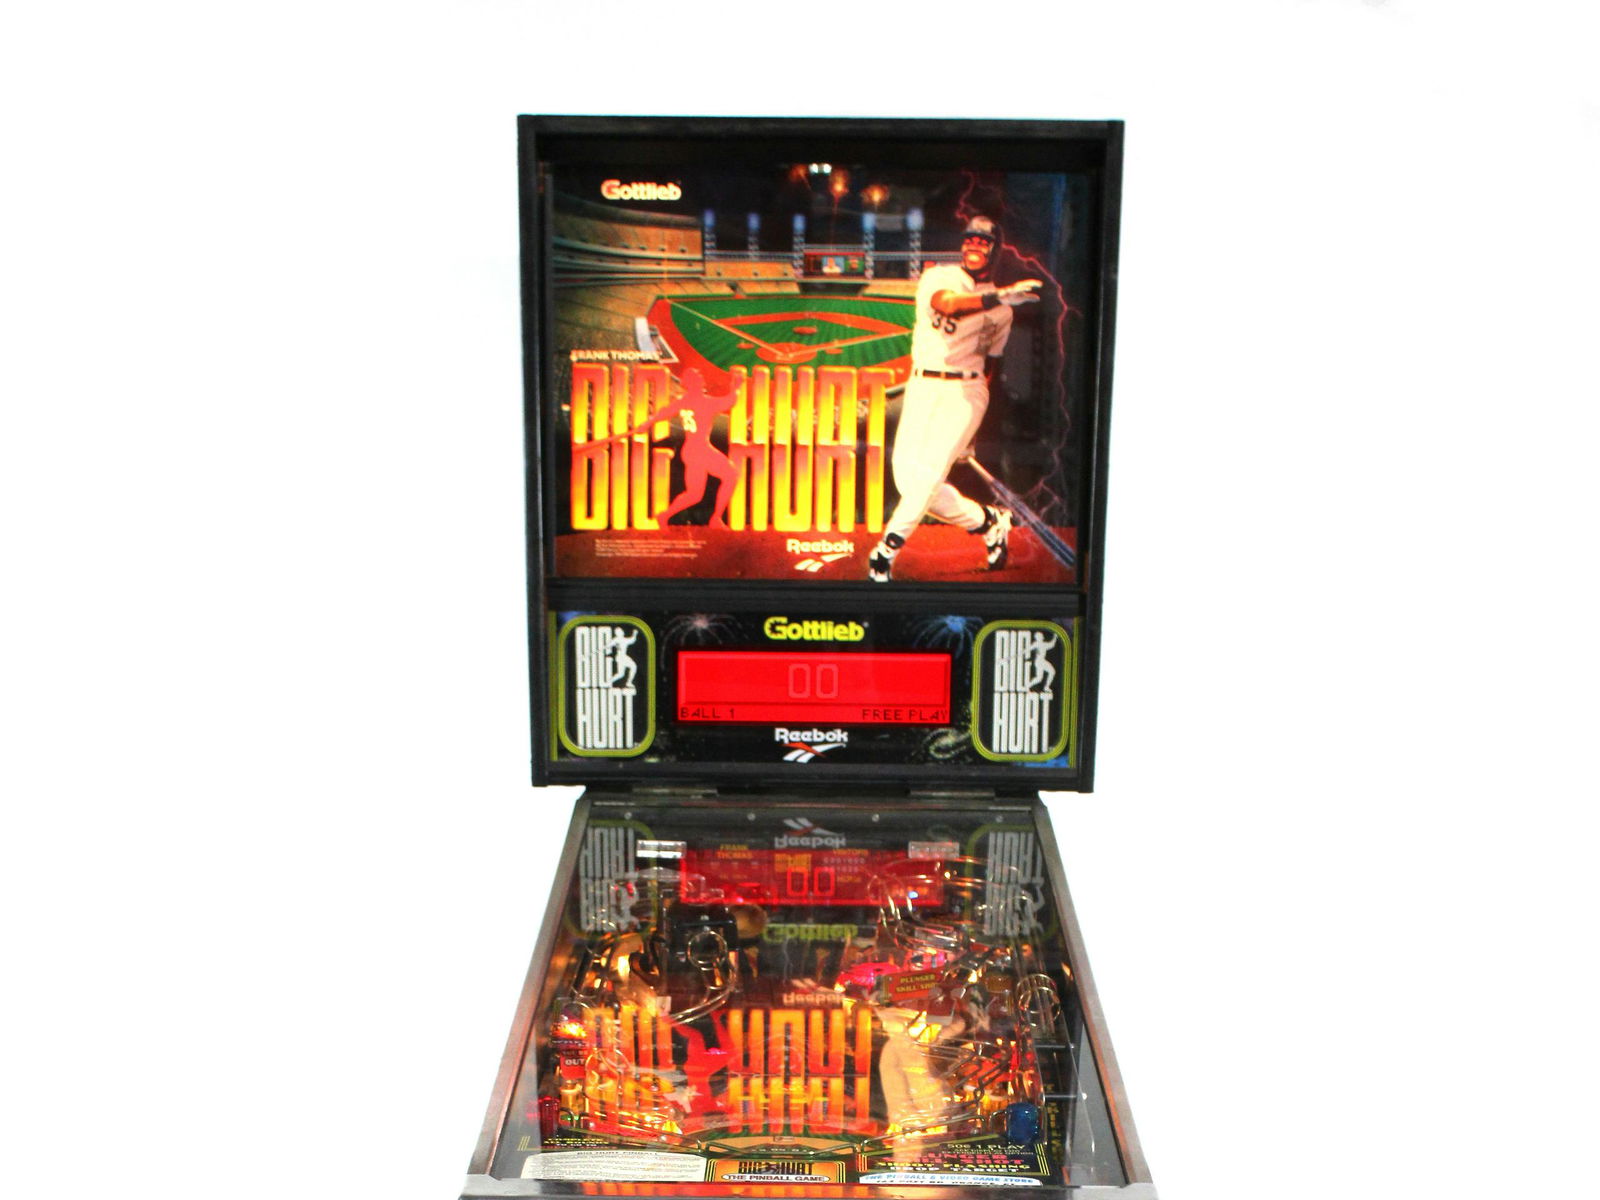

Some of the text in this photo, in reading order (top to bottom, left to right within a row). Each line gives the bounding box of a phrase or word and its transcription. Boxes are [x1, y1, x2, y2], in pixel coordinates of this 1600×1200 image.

[601, 179, 682, 200] Gottlieb
[932, 310, 957, 334] 35
[571, 363, 896, 533] BIG HURT
[787, 538, 854, 554] Reebok
[764, 616, 866, 641] Gottlieb
[575, 626, 614, 688] BIG
[993, 630, 1033, 692] BIG
[576, 687, 637, 749] HURT
[680, 707, 721, 719] BALL
[862, 709, 949, 721] FREE PLAY
[992, 692, 1054, 754] HURT
[774, 727, 848, 744] Reebok
[564, 1058, 586, 1067] OUT
[749, 1174, 792, 1182] PINBALL
